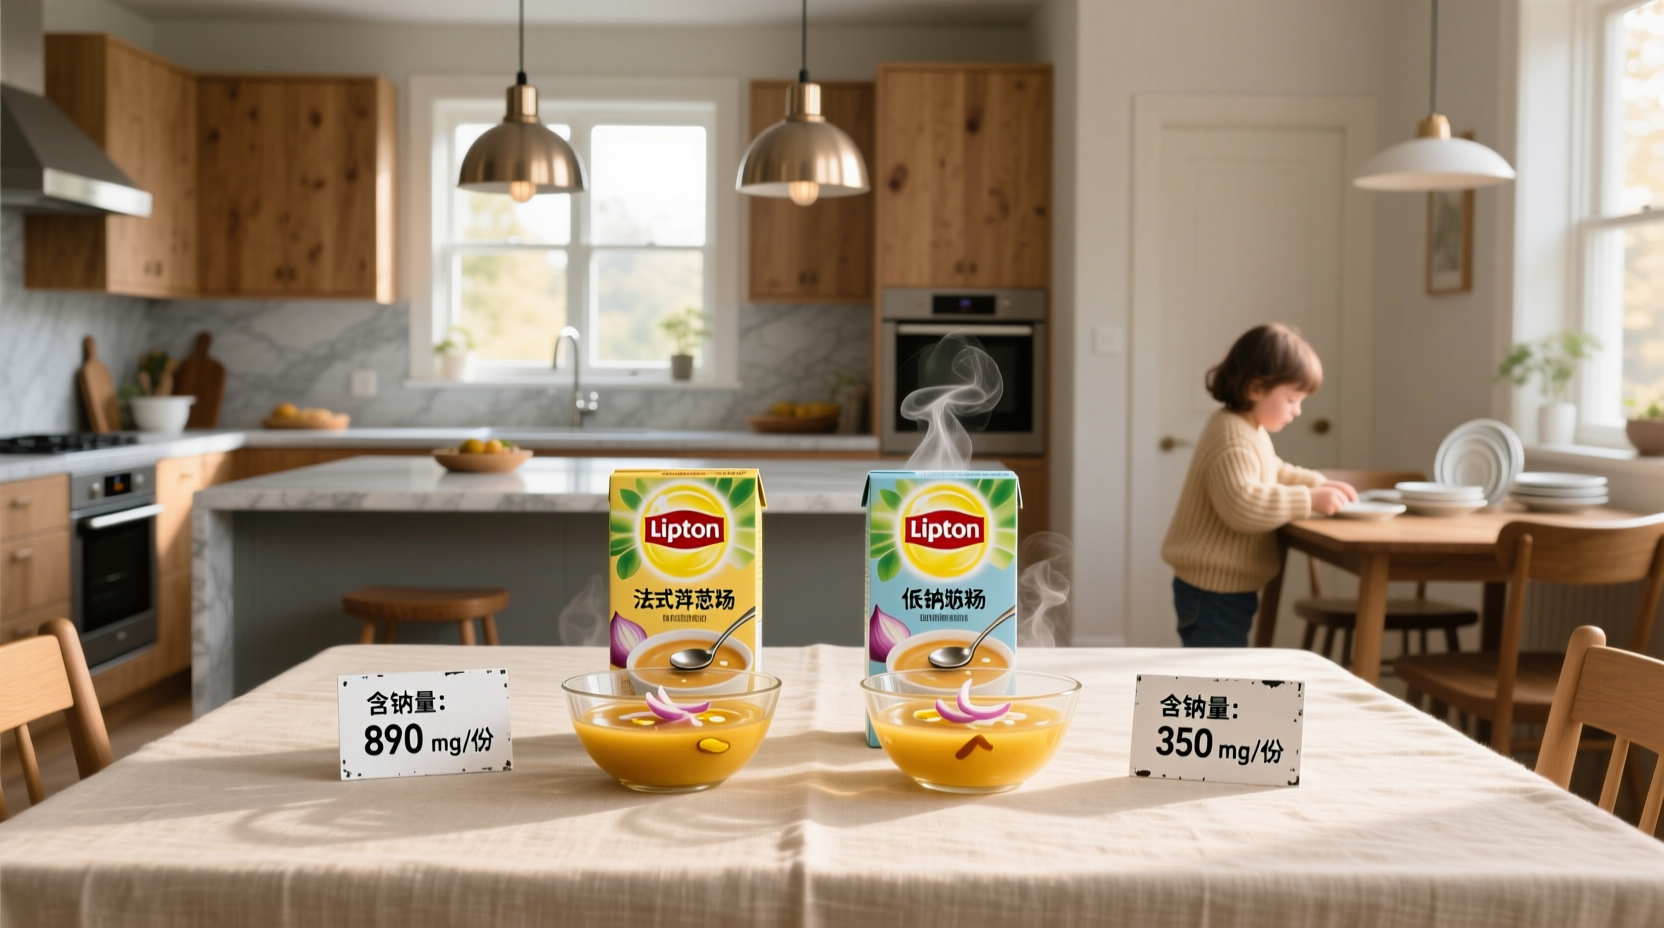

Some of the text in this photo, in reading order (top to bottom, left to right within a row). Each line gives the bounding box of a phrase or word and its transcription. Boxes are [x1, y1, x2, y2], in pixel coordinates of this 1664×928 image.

[651, 517, 720, 543] Lipton
[911, 517, 980, 543] Lipton
[366, 690, 446, 716] 含钠量：
[1160, 693, 1239, 720] 含钠量：
[364, 723, 495, 757] 890 mg/份
[1155, 725, 1284, 766] 350 mg/份
